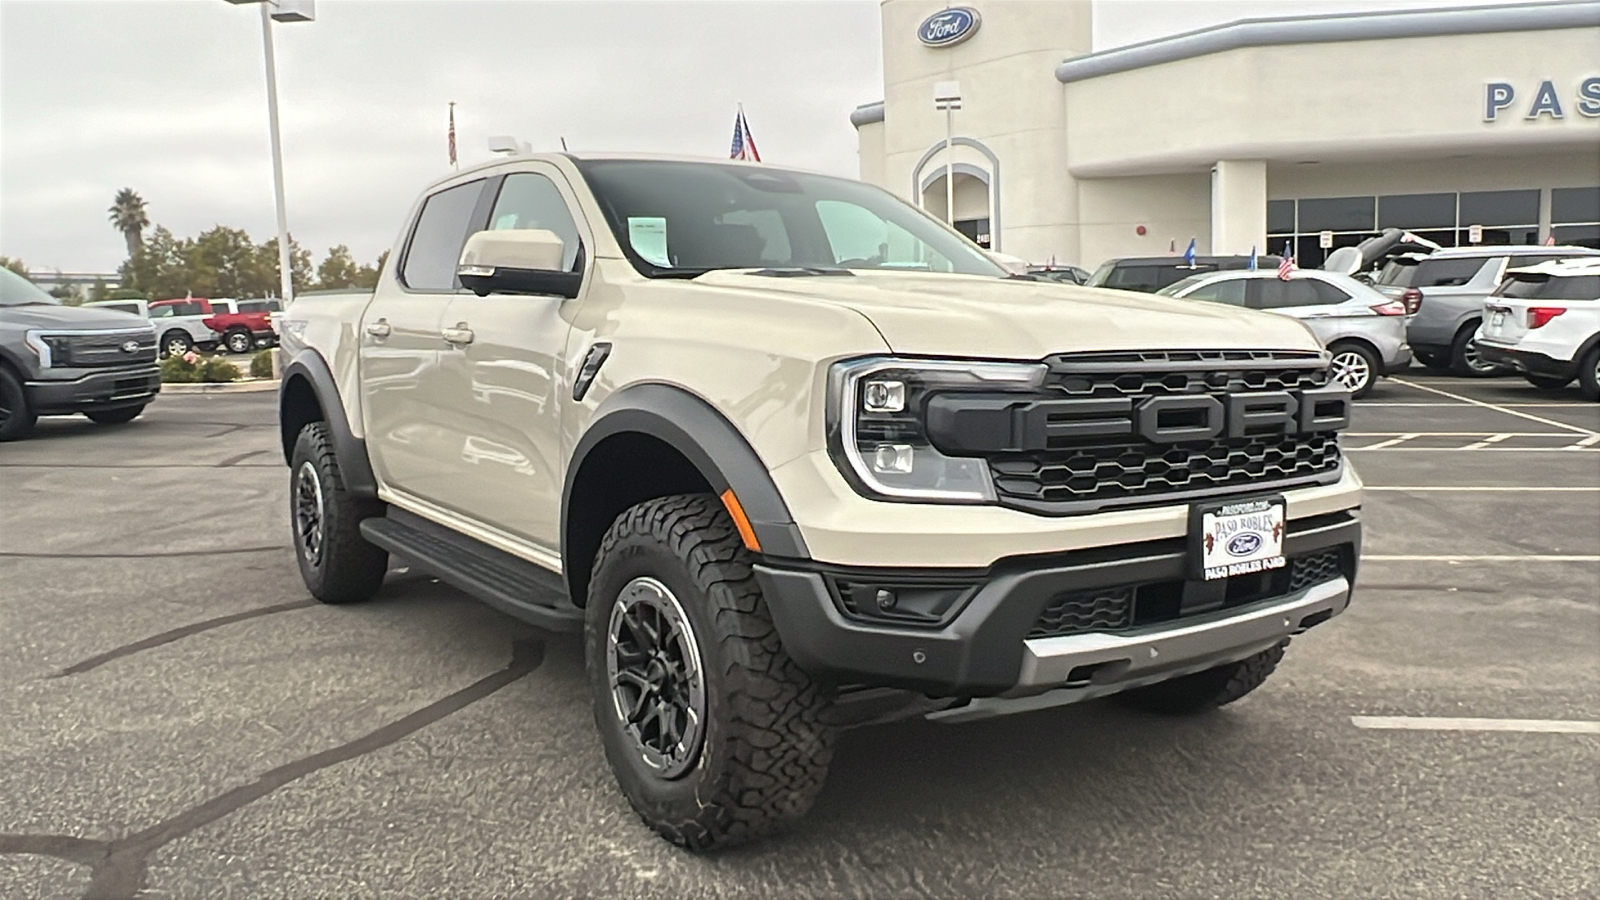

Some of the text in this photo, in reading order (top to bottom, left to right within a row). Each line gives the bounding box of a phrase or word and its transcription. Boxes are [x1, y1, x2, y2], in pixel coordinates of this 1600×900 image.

[926, 14, 962, 40] Ford
[1015, 390, 1351, 450] FORD
[1214, 514, 1273, 541] PASO ROBLES
[1232, 535, 1258, 553] Ford
[1205, 566, 1228, 581] PASO
[1229, 560, 1262, 576] ROBLES
